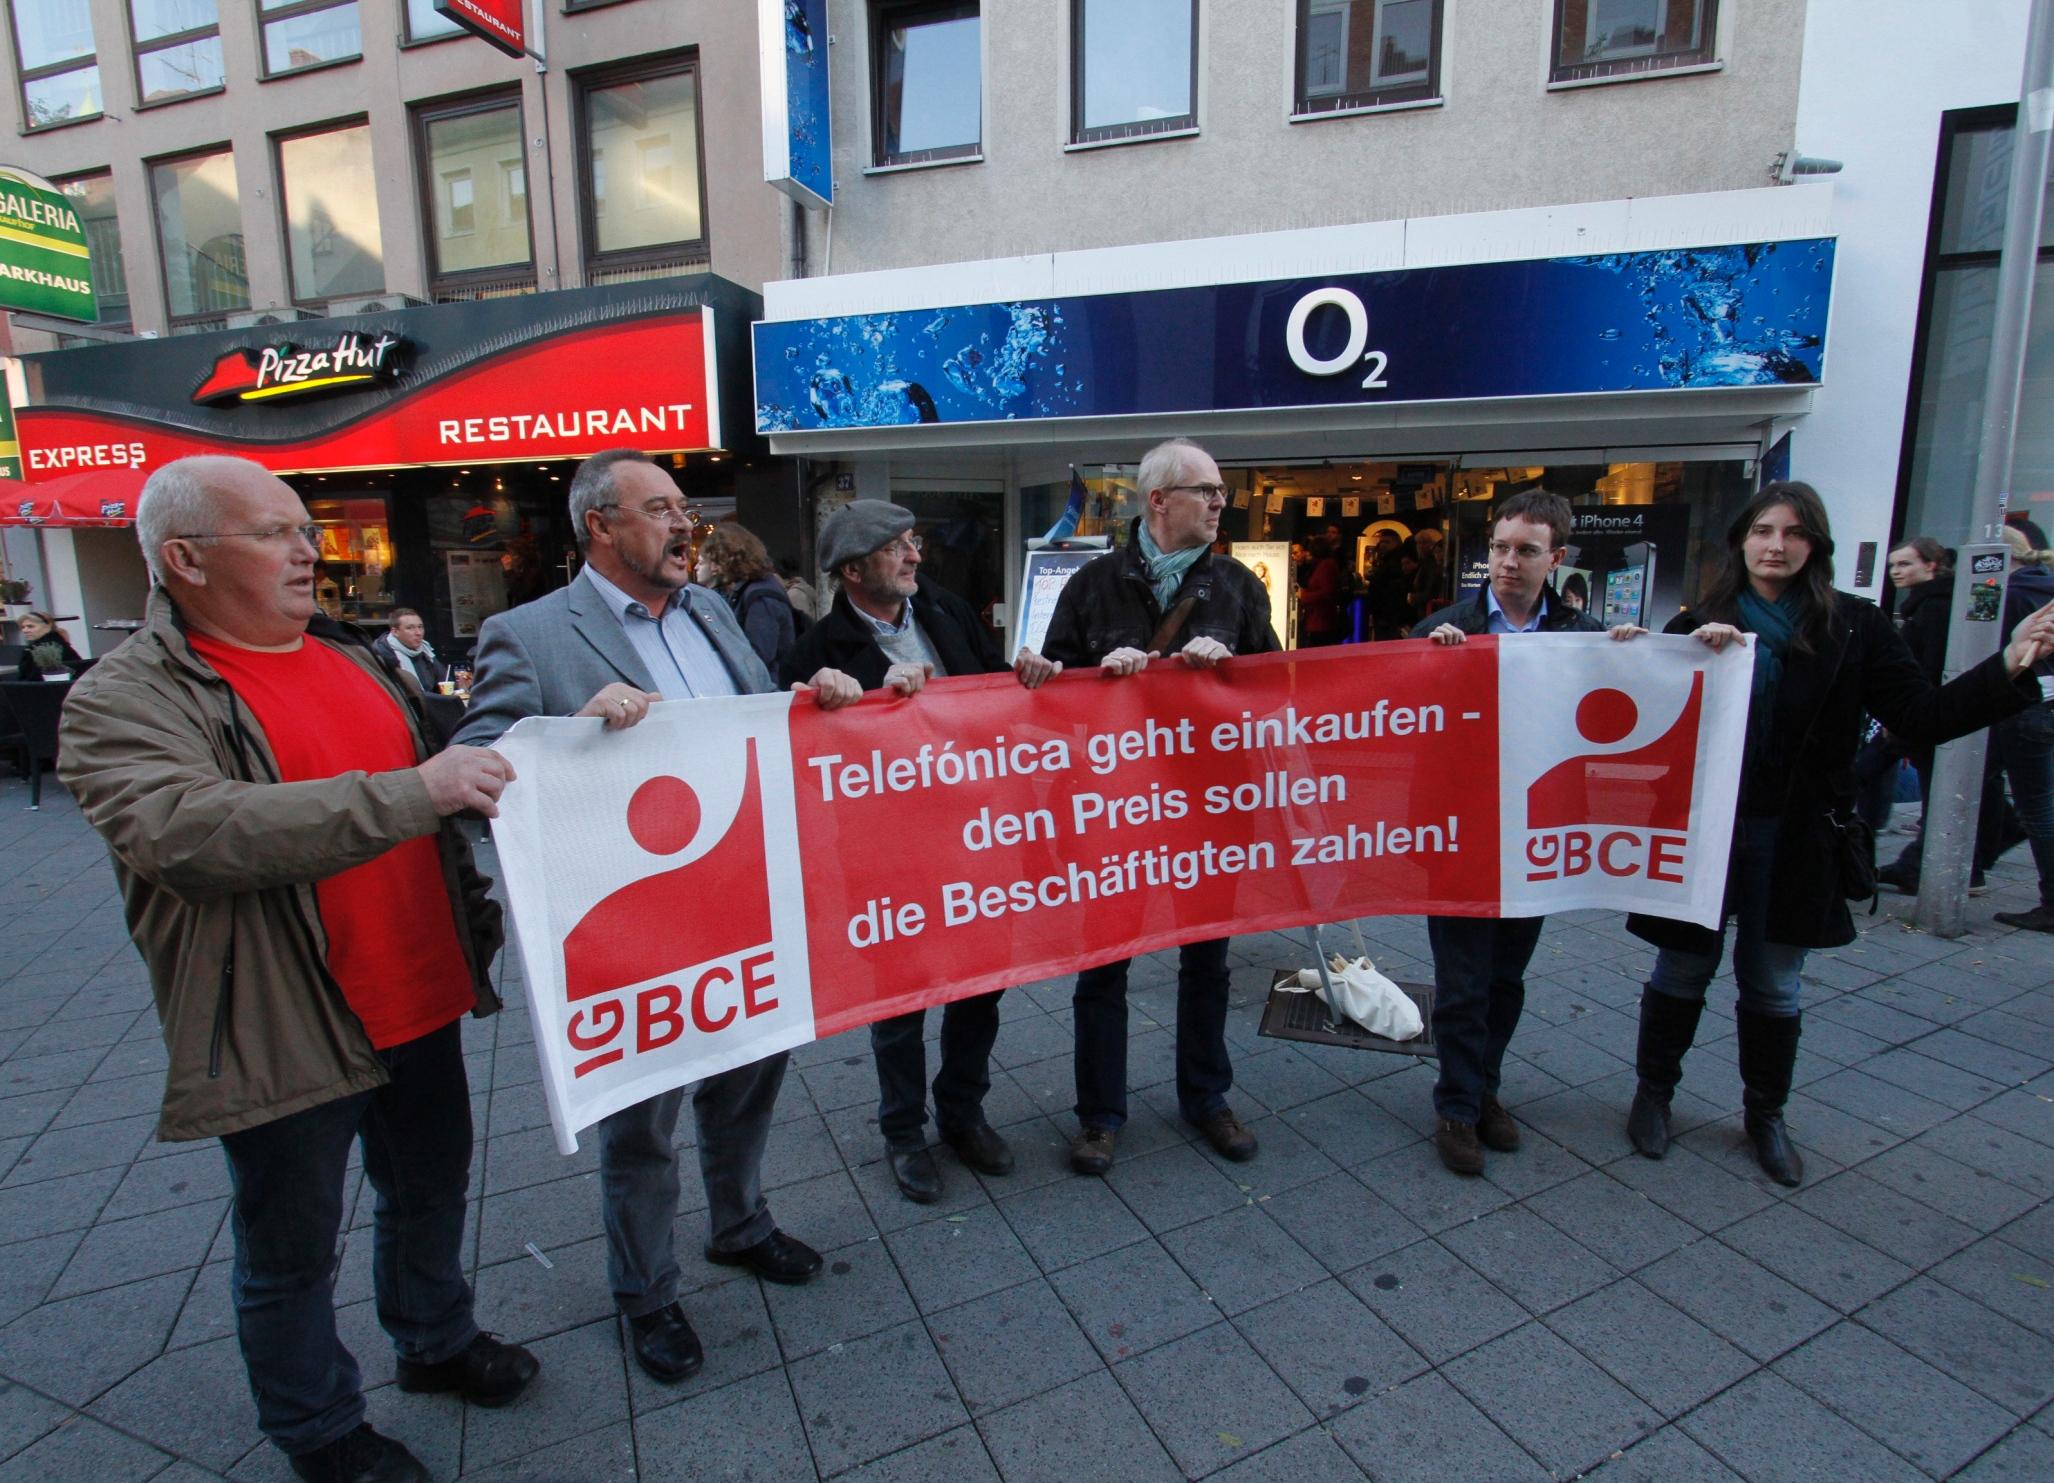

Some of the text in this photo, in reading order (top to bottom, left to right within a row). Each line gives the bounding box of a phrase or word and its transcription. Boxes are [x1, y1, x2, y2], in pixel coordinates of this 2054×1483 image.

[456, 0, 521, 40] ESTAURANT
[0, 263, 91, 295] ARKHAUS
[257, 335, 396, 388] Pizza Hut
[439, 404, 692, 444] RESTAURANT
[29, 443, 146, 469] EXPRESS
[1580, 514, 1644, 528] iPhone 4
[808, 735, 1071, 802] Telefónica
[1088, 717, 1195, 775] geht
[1210, 699, 1445, 752] einkaufen
[963, 771, 1347, 852] den Preis sollen
[847, 815, 1460, 949] die Beschäftigten zahlen!
[1563, 830, 1688, 884] BCE
[636, 950, 779, 1056] BCE
